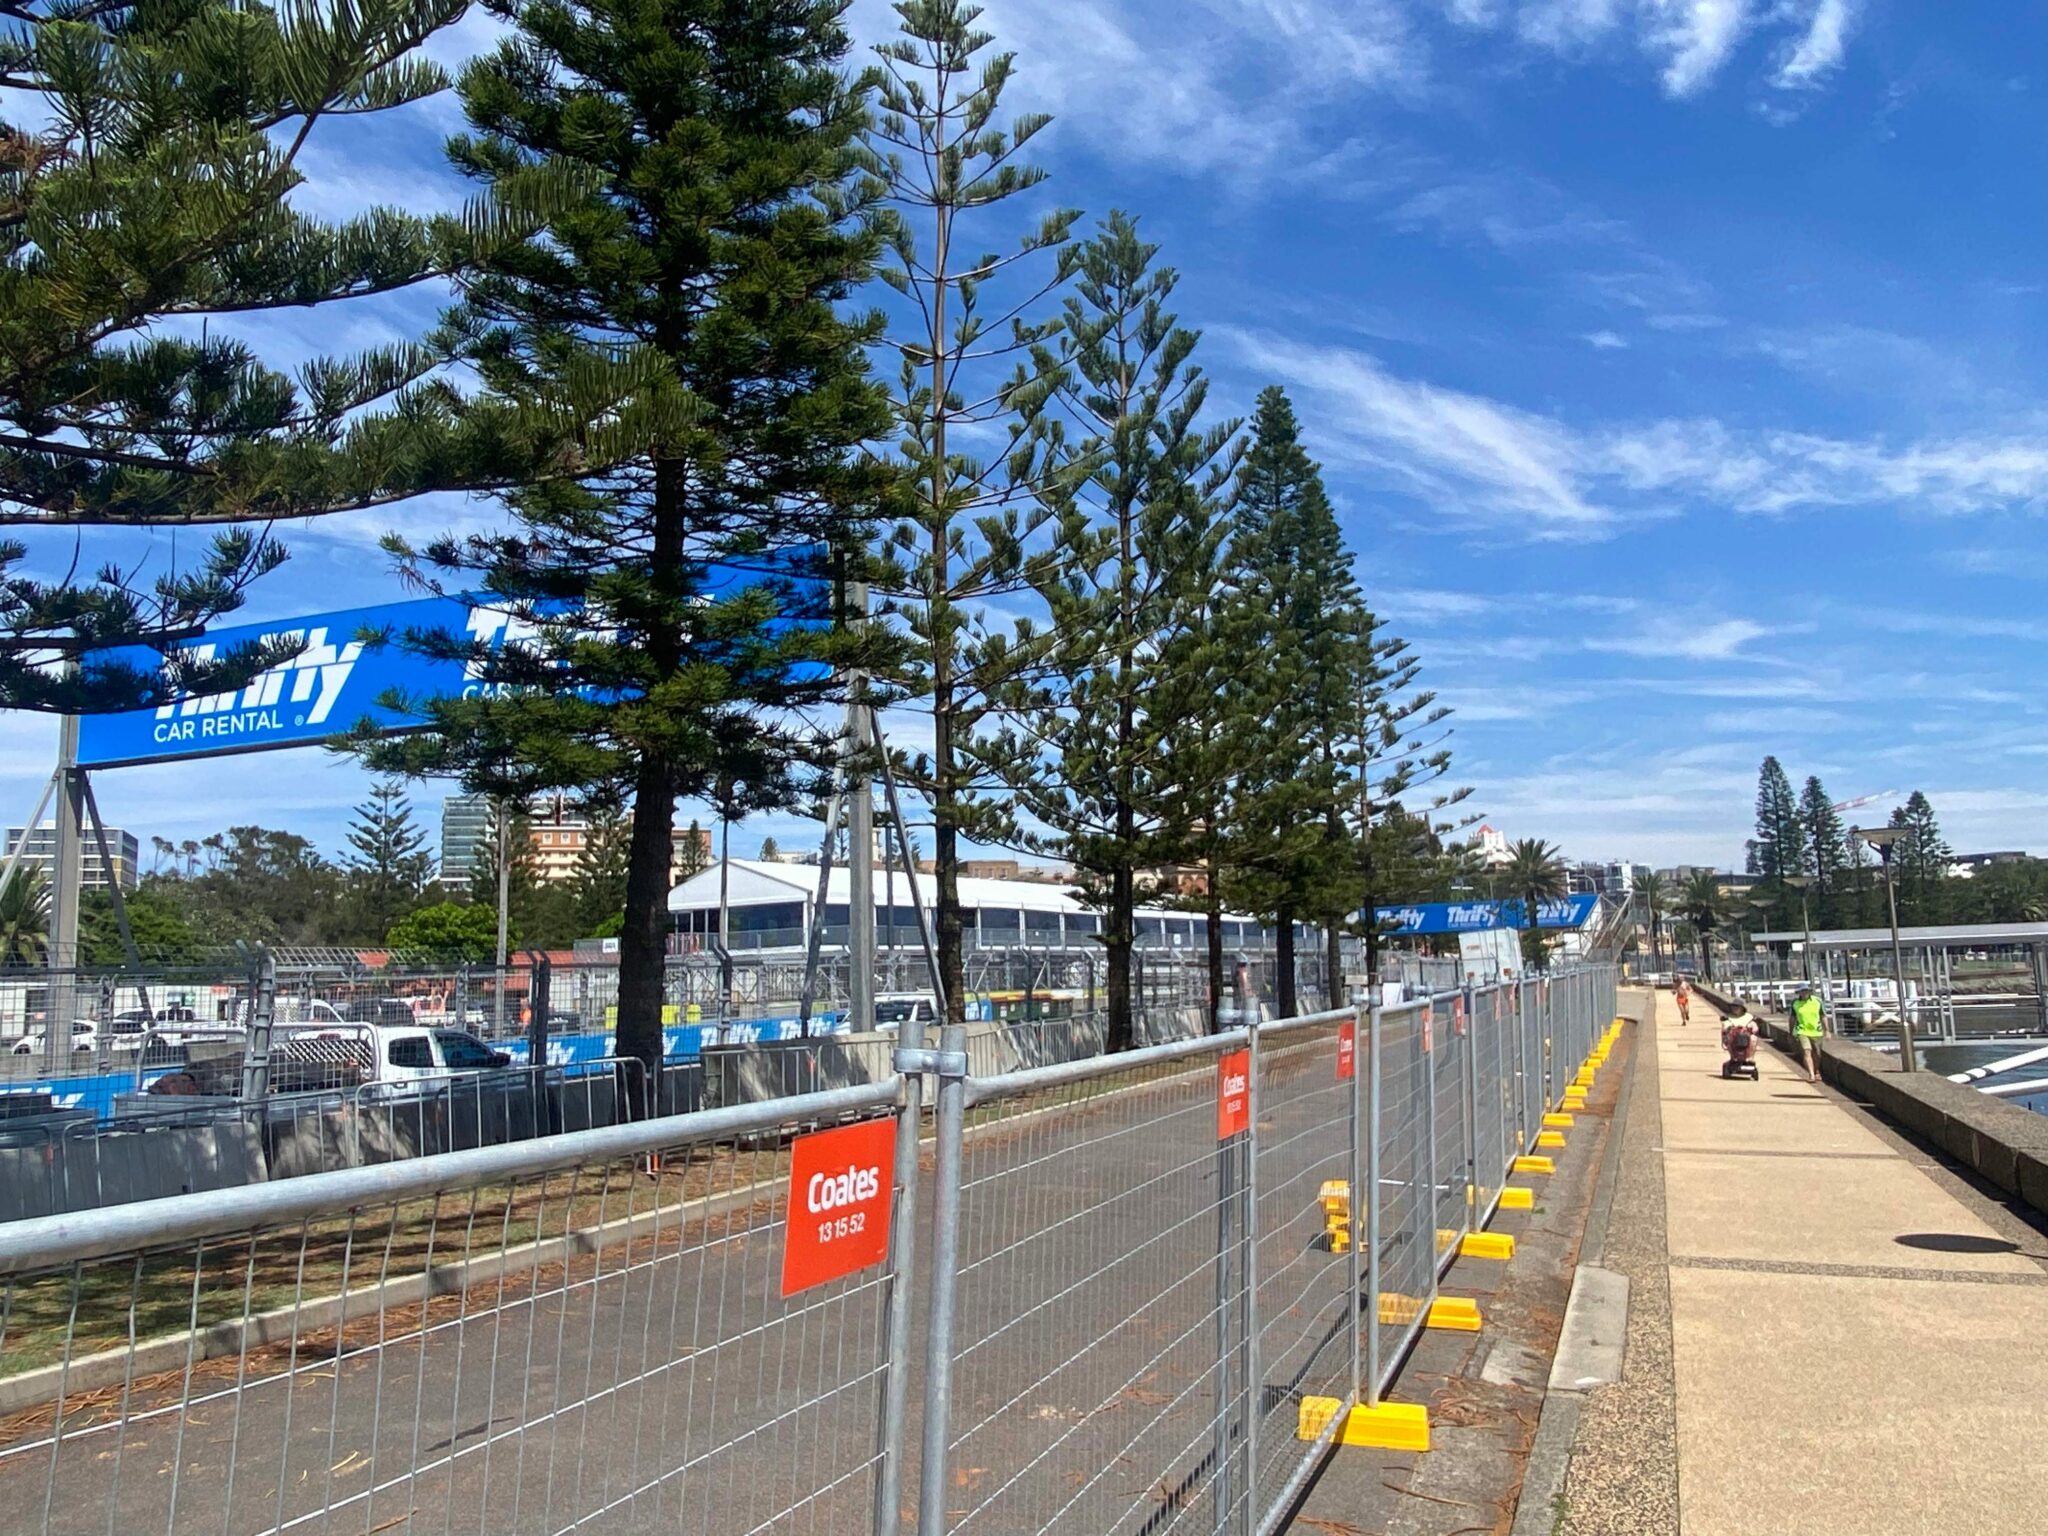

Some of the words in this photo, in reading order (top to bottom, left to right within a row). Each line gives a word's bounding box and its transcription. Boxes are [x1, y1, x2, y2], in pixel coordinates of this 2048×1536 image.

[154, 721, 195, 742] CAR
[202, 709, 283, 737] RENTAL
[808, 1165, 879, 1213] Coates
[818, 1222, 832, 1243] 13
[834, 1217, 848, 1238] 15
[849, 1212, 865, 1234] 52
